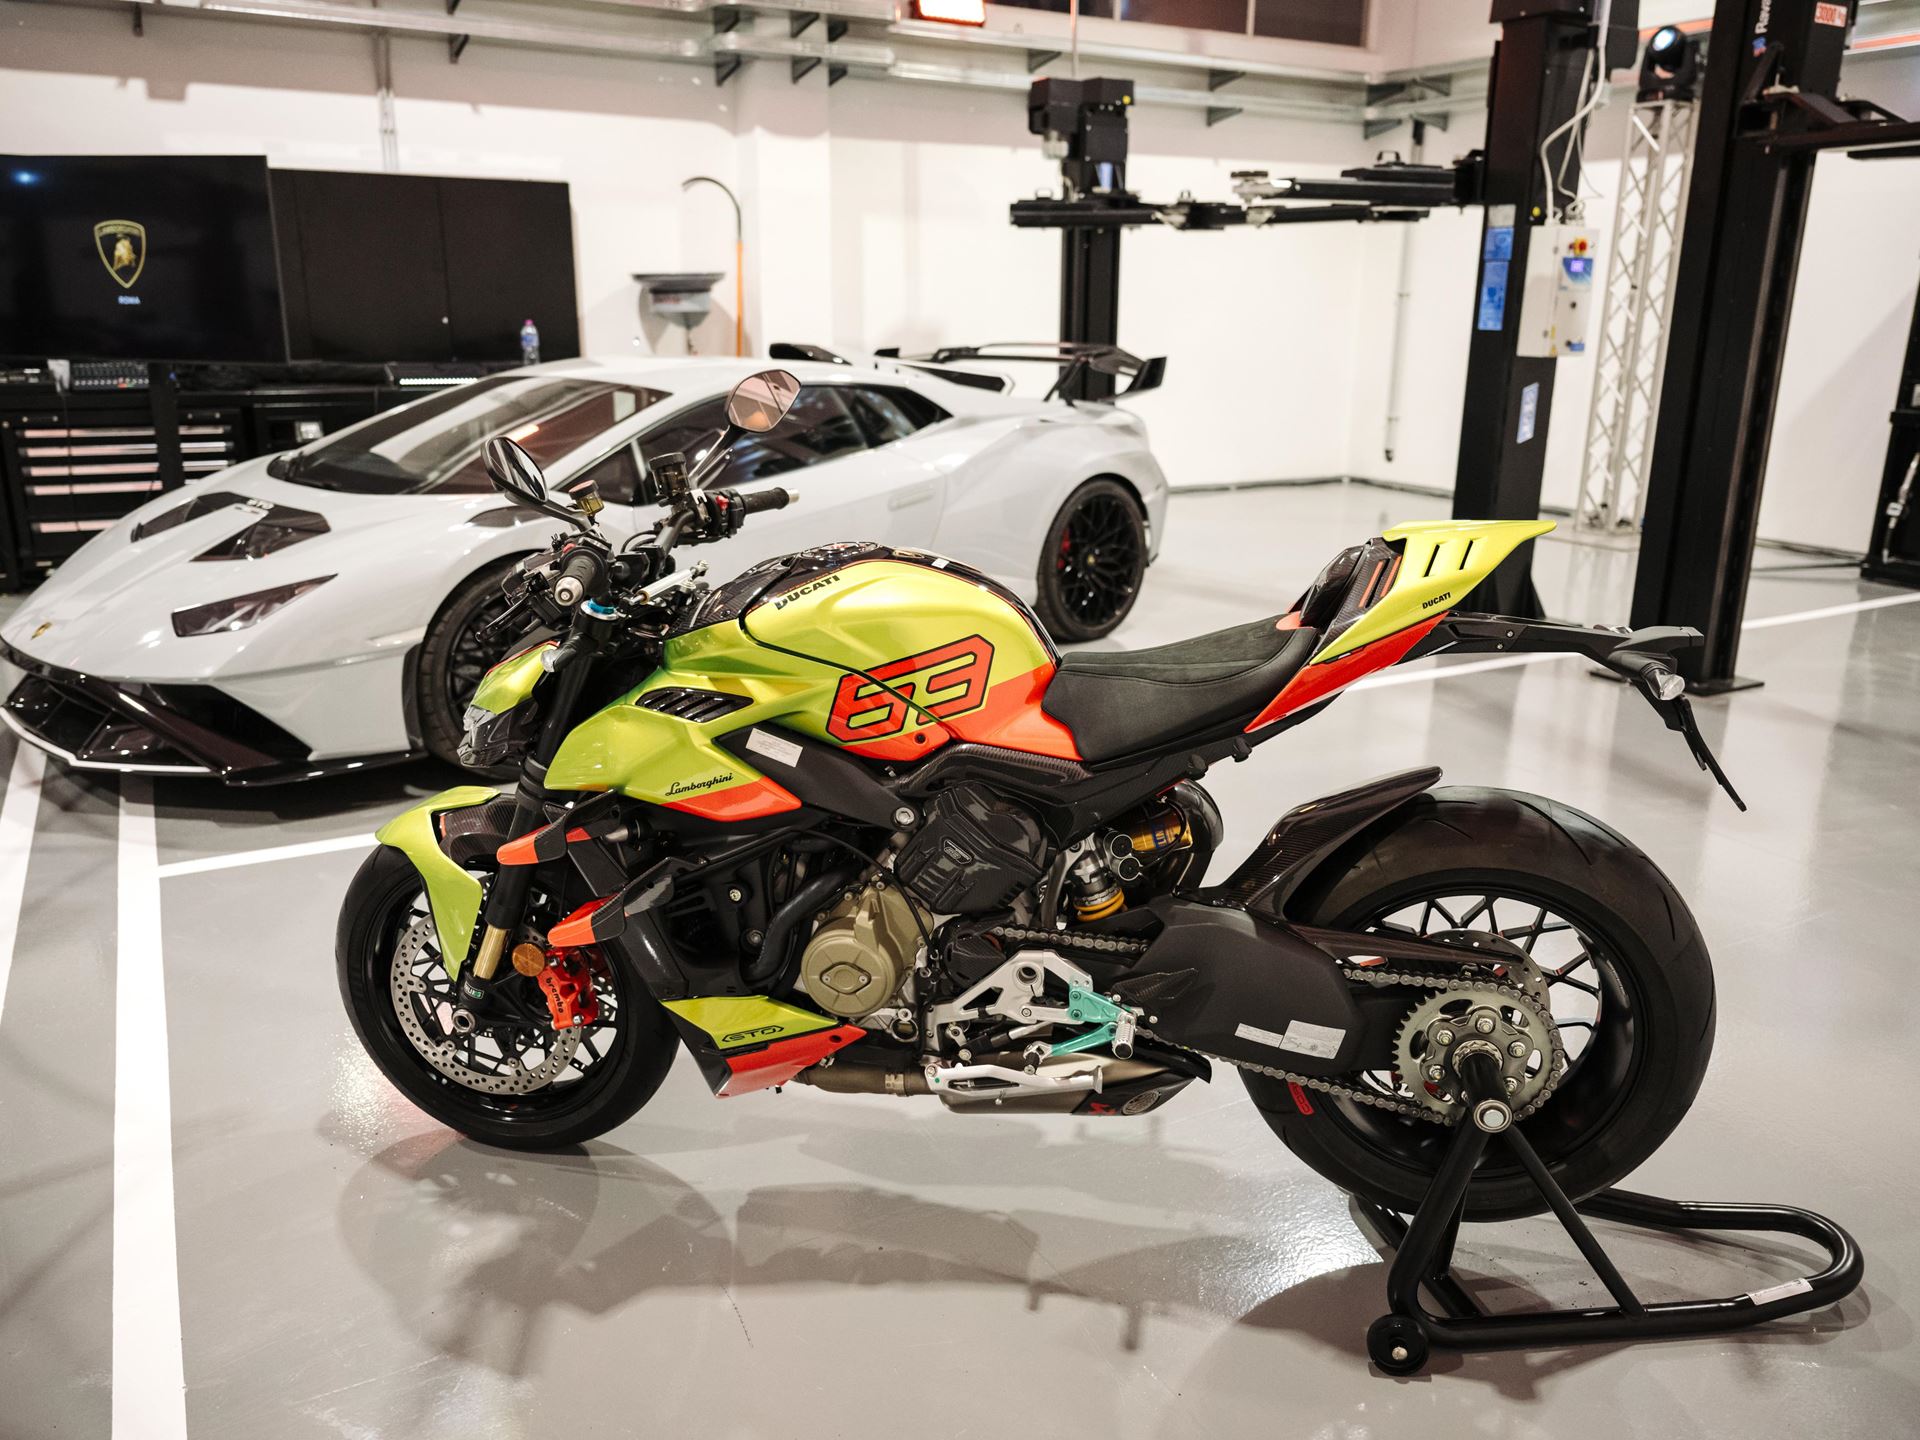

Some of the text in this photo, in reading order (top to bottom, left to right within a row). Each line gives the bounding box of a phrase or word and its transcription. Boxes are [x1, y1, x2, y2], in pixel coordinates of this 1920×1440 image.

[774, 575, 840, 610] DUCATI
[1422, 592, 1451, 609] DUCATI
[826, 634, 995, 743] 63
[665, 773, 733, 796] Lamborghini
[546, 977, 564, 1013] brembo
[728, 1026, 777, 1041] STO
